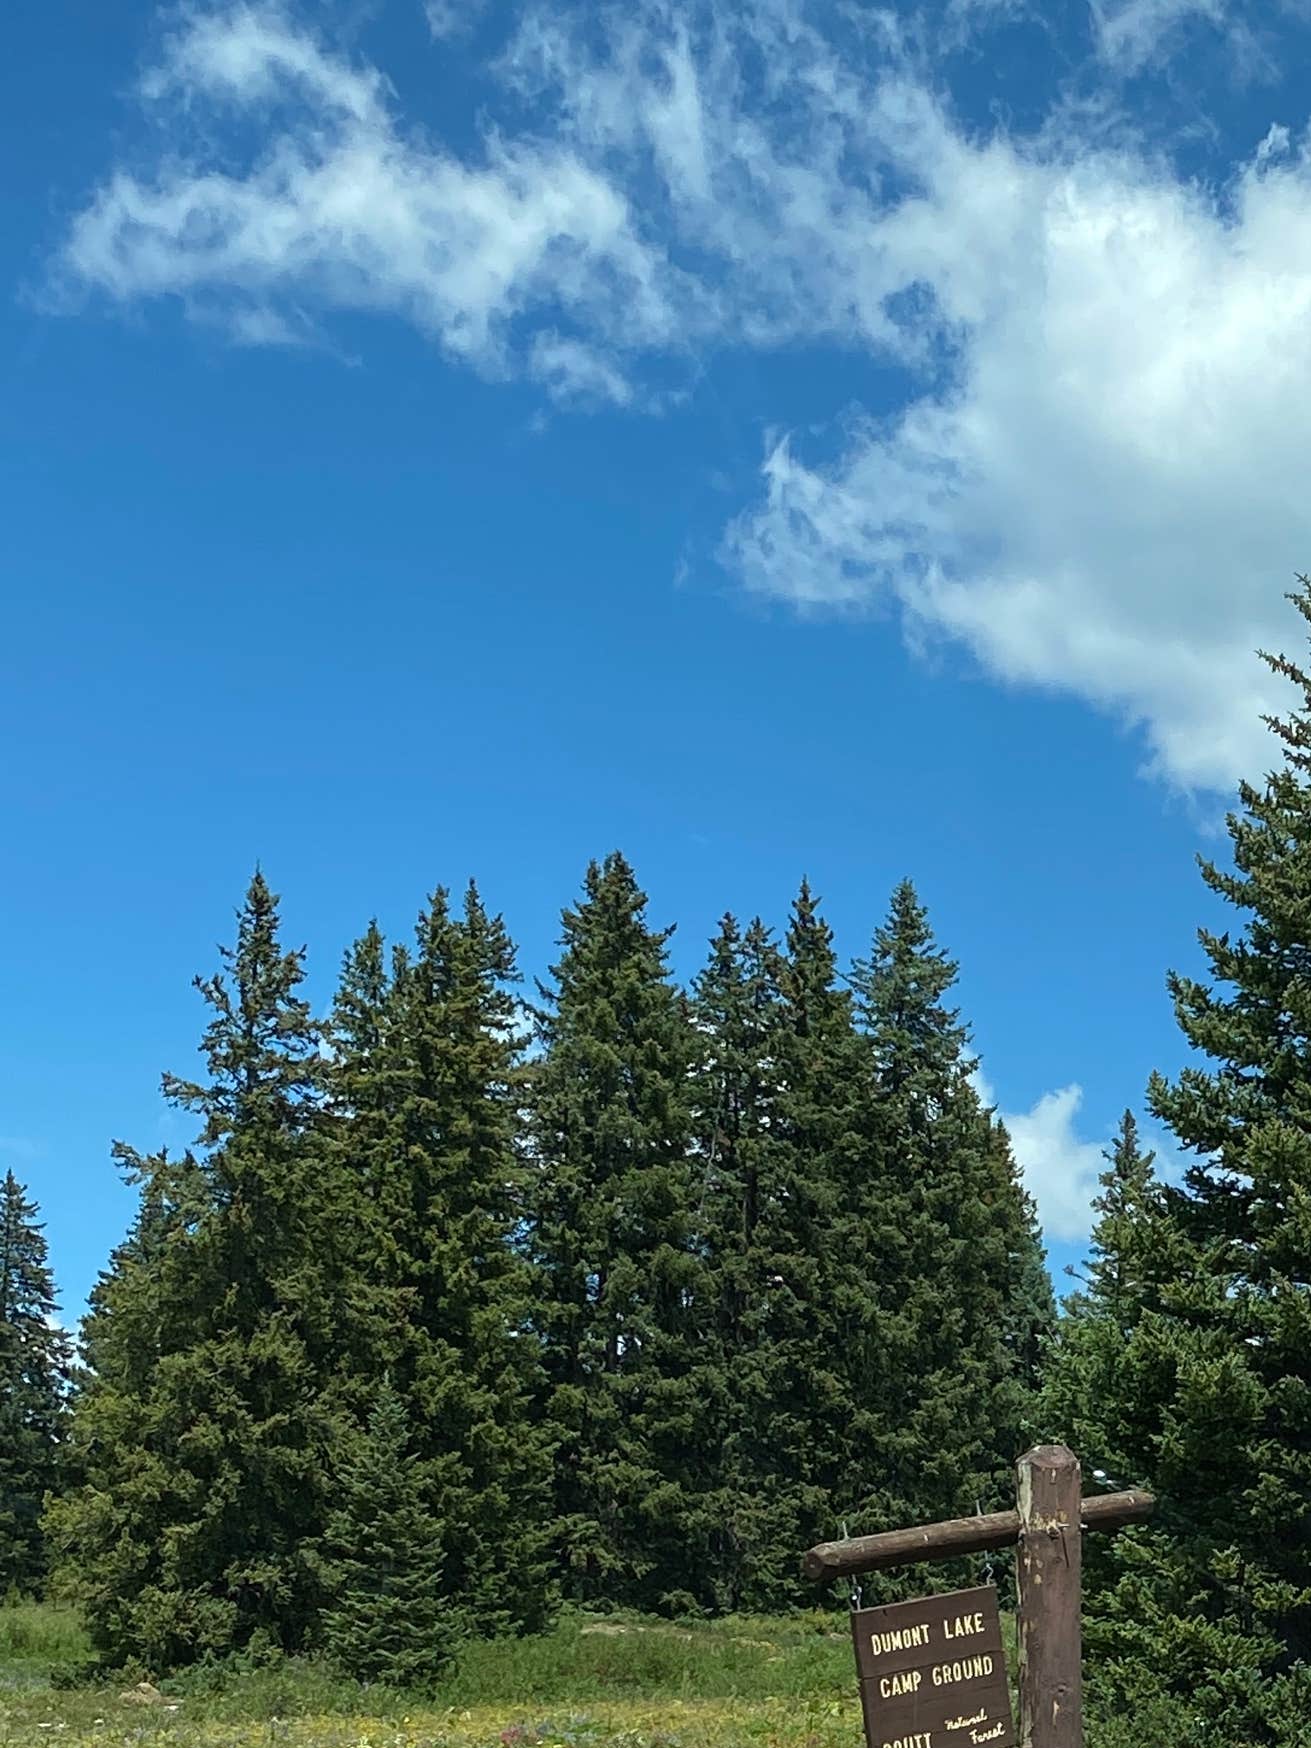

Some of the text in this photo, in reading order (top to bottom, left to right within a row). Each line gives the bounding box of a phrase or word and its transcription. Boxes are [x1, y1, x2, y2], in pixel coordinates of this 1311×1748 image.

[871, 1612, 985, 1655] DUMONT LAKE
[880, 1655, 993, 1698] CAMP GROUND
